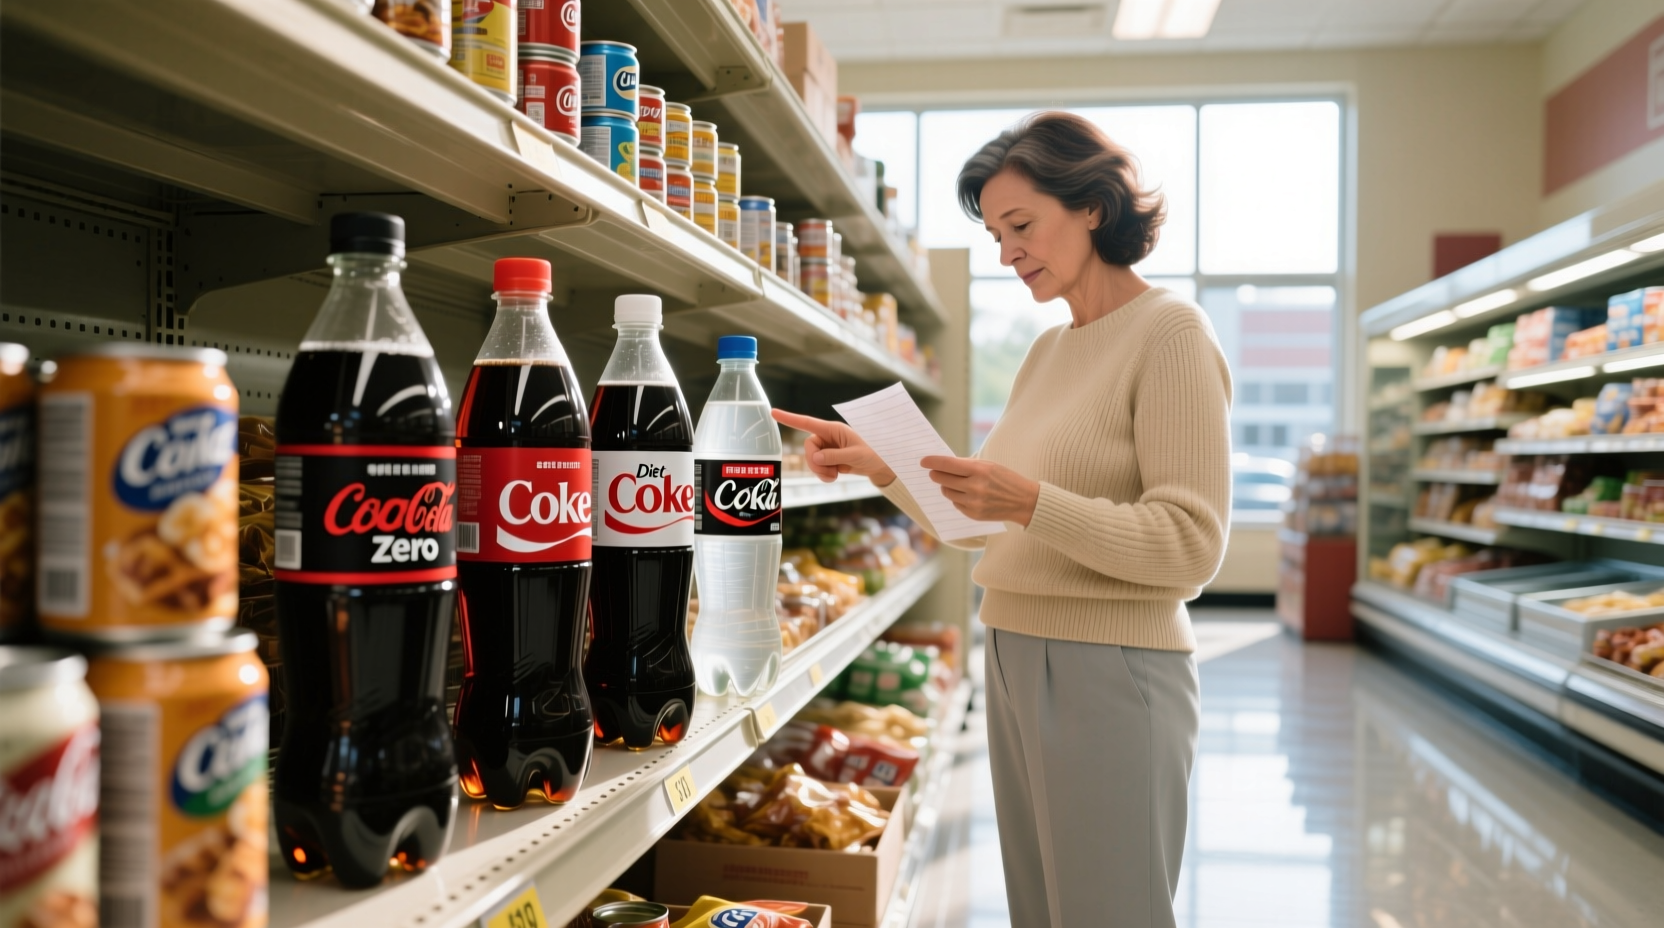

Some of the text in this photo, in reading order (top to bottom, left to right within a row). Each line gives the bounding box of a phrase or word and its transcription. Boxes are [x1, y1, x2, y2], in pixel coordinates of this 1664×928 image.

[636, 463, 667, 479] Diet
[498, 479, 592, 526] Coke
[607, 472, 694, 514] Coke
[370, 535, 440, 564] Zero
